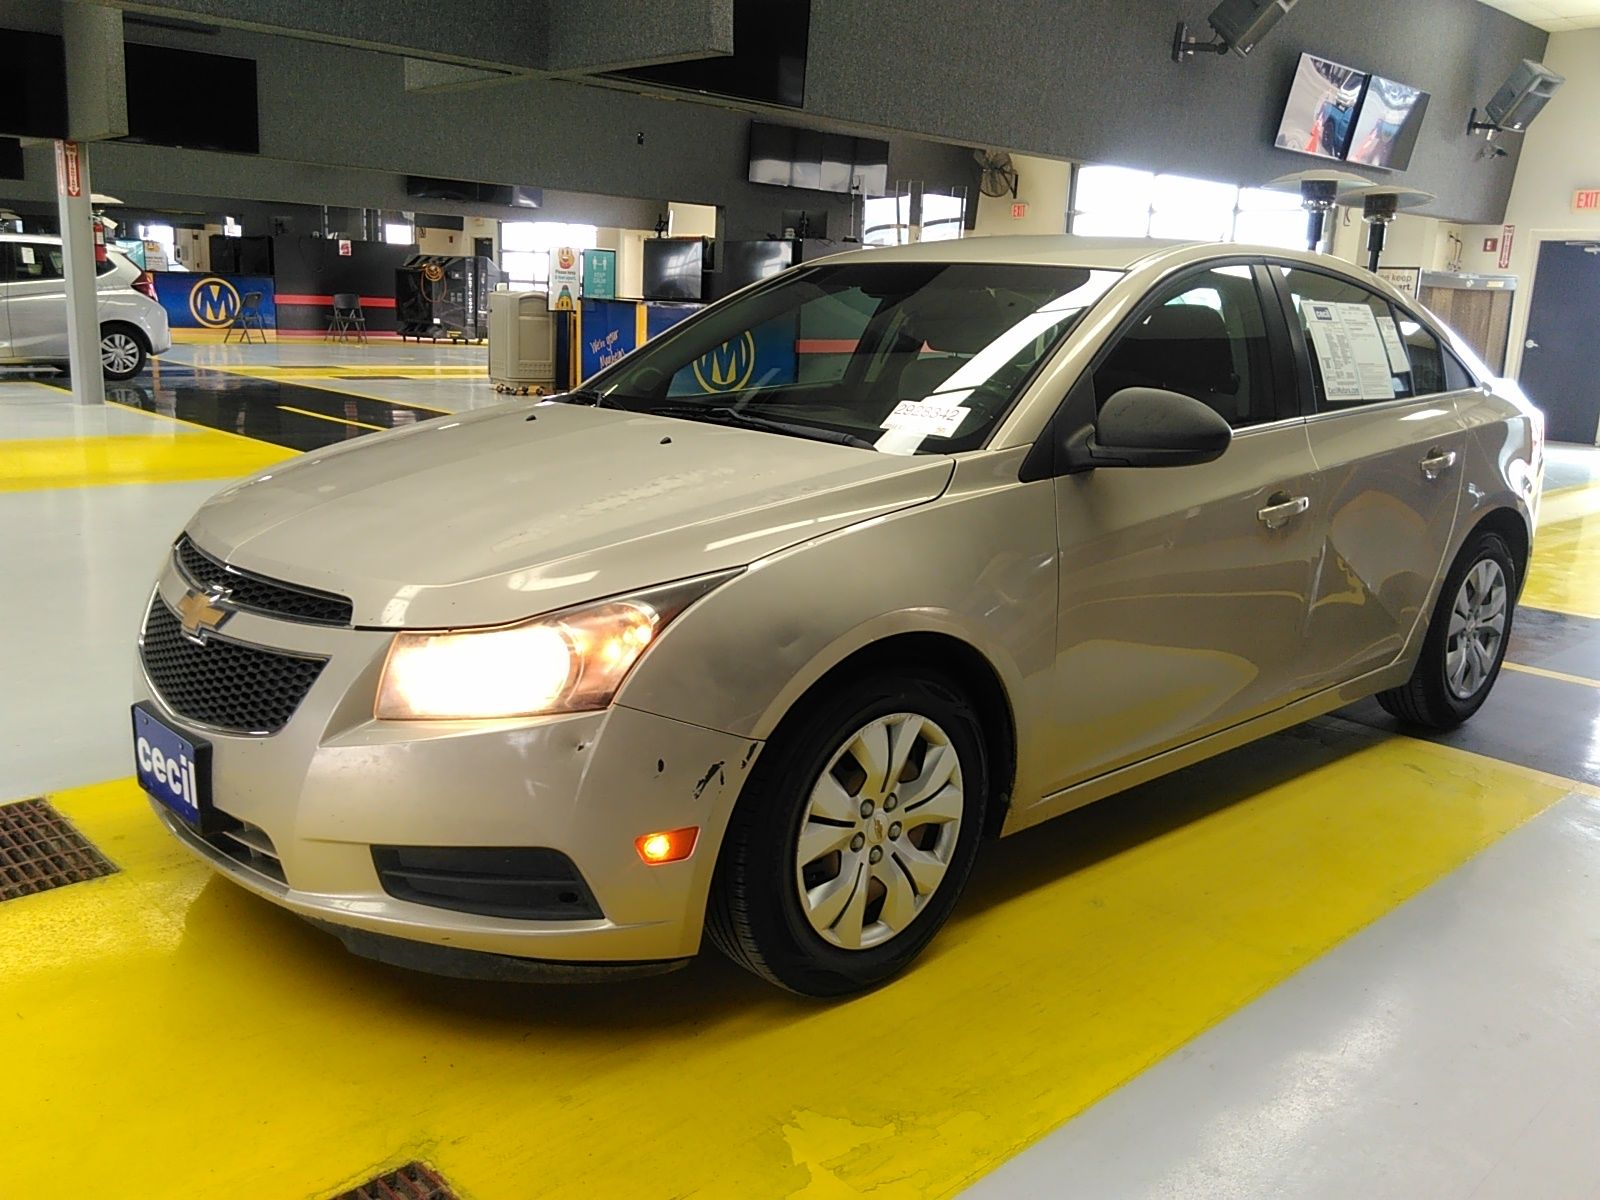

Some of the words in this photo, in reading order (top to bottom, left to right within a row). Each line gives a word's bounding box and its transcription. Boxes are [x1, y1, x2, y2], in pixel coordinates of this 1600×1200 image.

[1576, 191, 1600, 209] EXIT
[1391, 273, 1412, 283] keep
[137, 736, 199, 810] cecil
